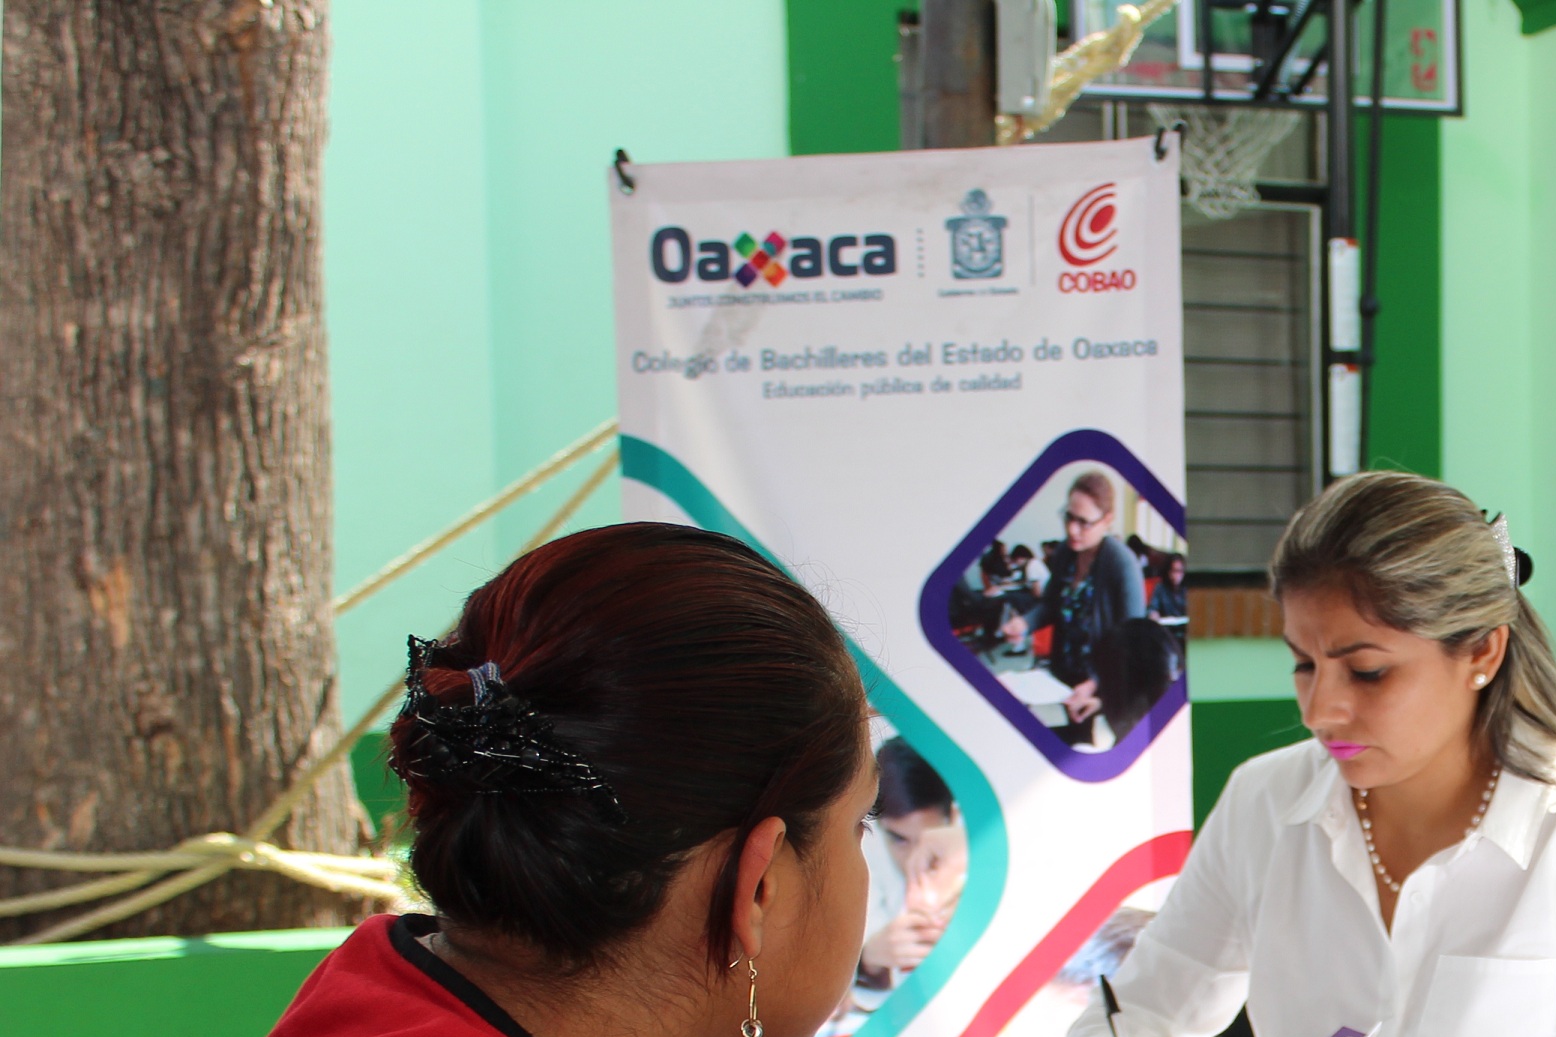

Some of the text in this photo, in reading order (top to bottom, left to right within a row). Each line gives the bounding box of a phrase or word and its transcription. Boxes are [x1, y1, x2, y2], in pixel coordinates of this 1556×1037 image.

[650, 225, 897, 288] Oaxaca
[1057, 269, 1136, 294] COBAO
[631, 337, 1158, 378] Colegio de Bachilleres del Estado de Oaxaca
[762, 376, 856, 399] Educación
[930, 374, 952, 394] de
[956, 372, 1023, 393] calidad
